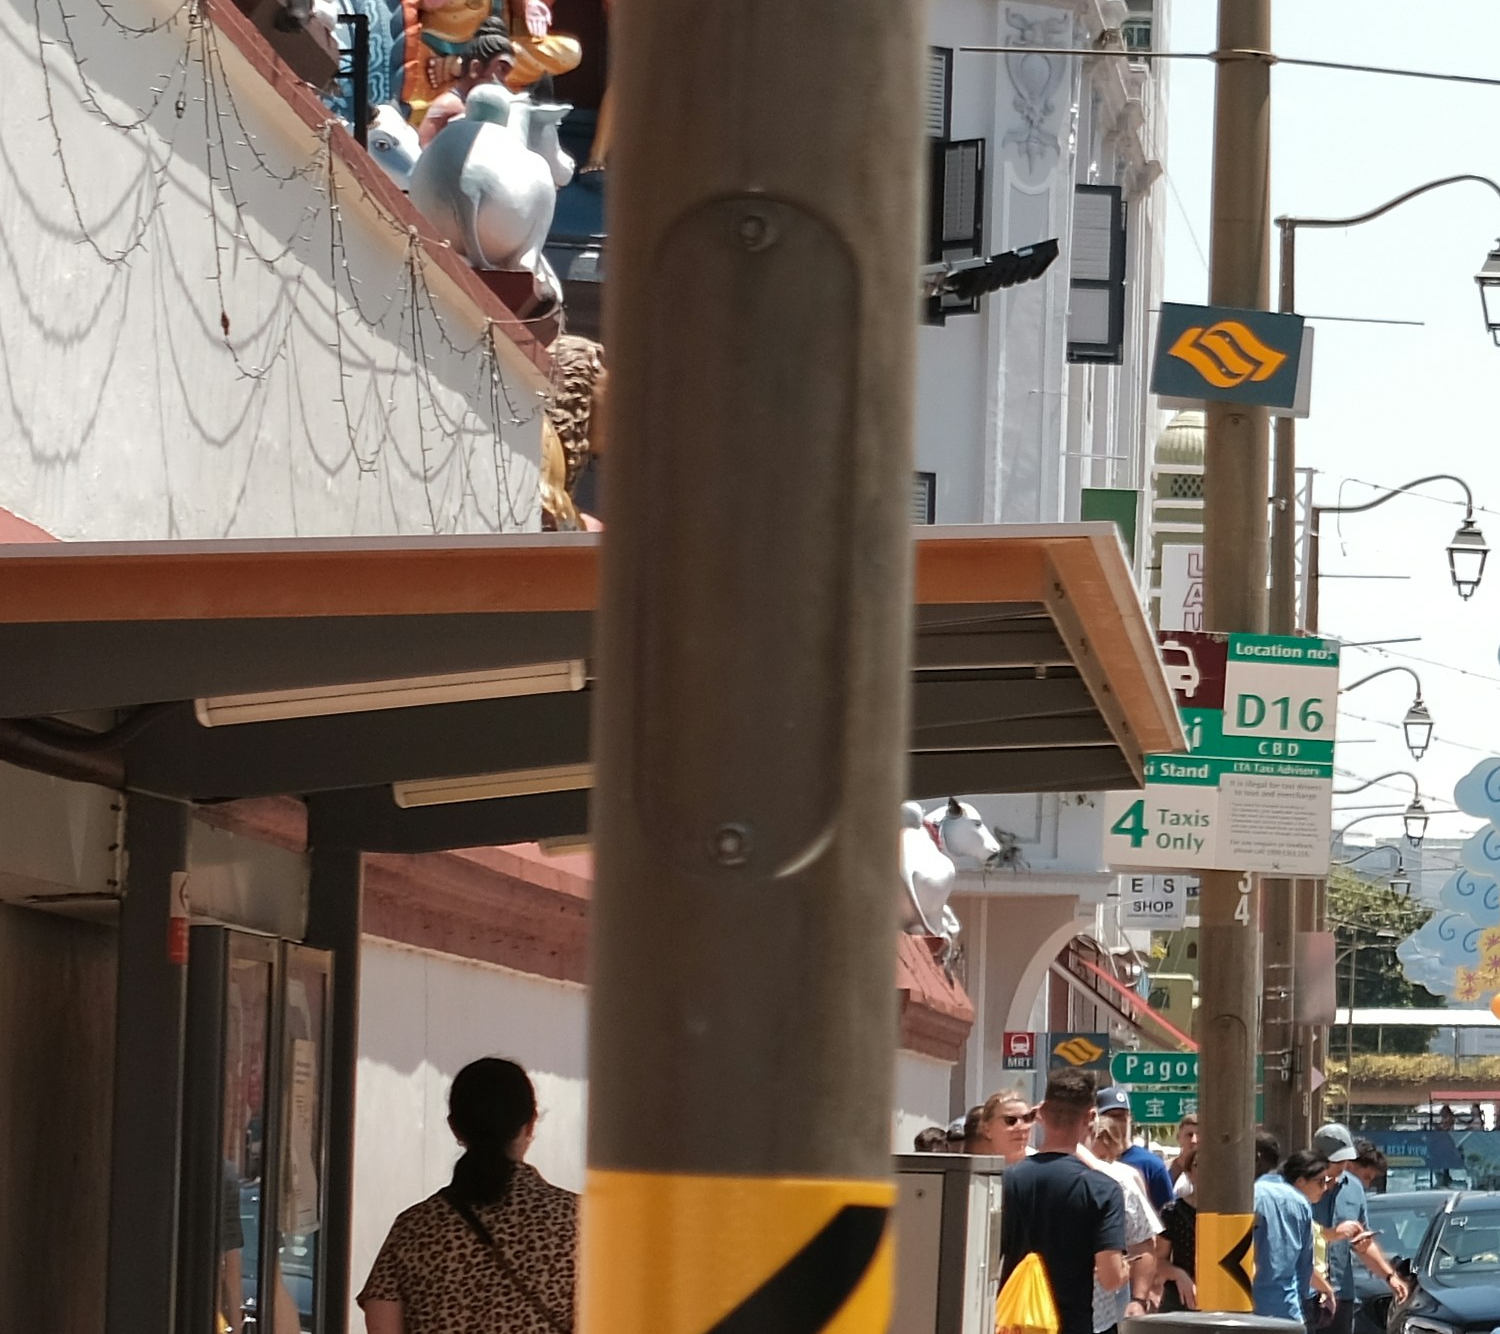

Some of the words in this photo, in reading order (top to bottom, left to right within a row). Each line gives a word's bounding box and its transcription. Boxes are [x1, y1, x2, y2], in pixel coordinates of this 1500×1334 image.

[1235, 641, 1302, 659] Location
[1235, 693, 1325, 733] D16
[1161, 762, 1209, 779] Stand
[1233, 762, 1250, 772] LTA
[1254, 763, 1274, 774] Taxi
[1277, 763, 1321, 777] Advisory
[1110, 799, 1149, 848] 4
[1156, 809, 1210, 828] Taxis
[1156, 832, 1204, 855] Only
[1131, 878, 1144, 893] E
[1162, 878, 1176, 894] S
[1132, 900, 1174, 913] SHOP
[1234, 871, 1252, 927] 34
[1006, 1057, 1032, 1068] MRT
[1387, 1144, 1405, 1155] BEST
